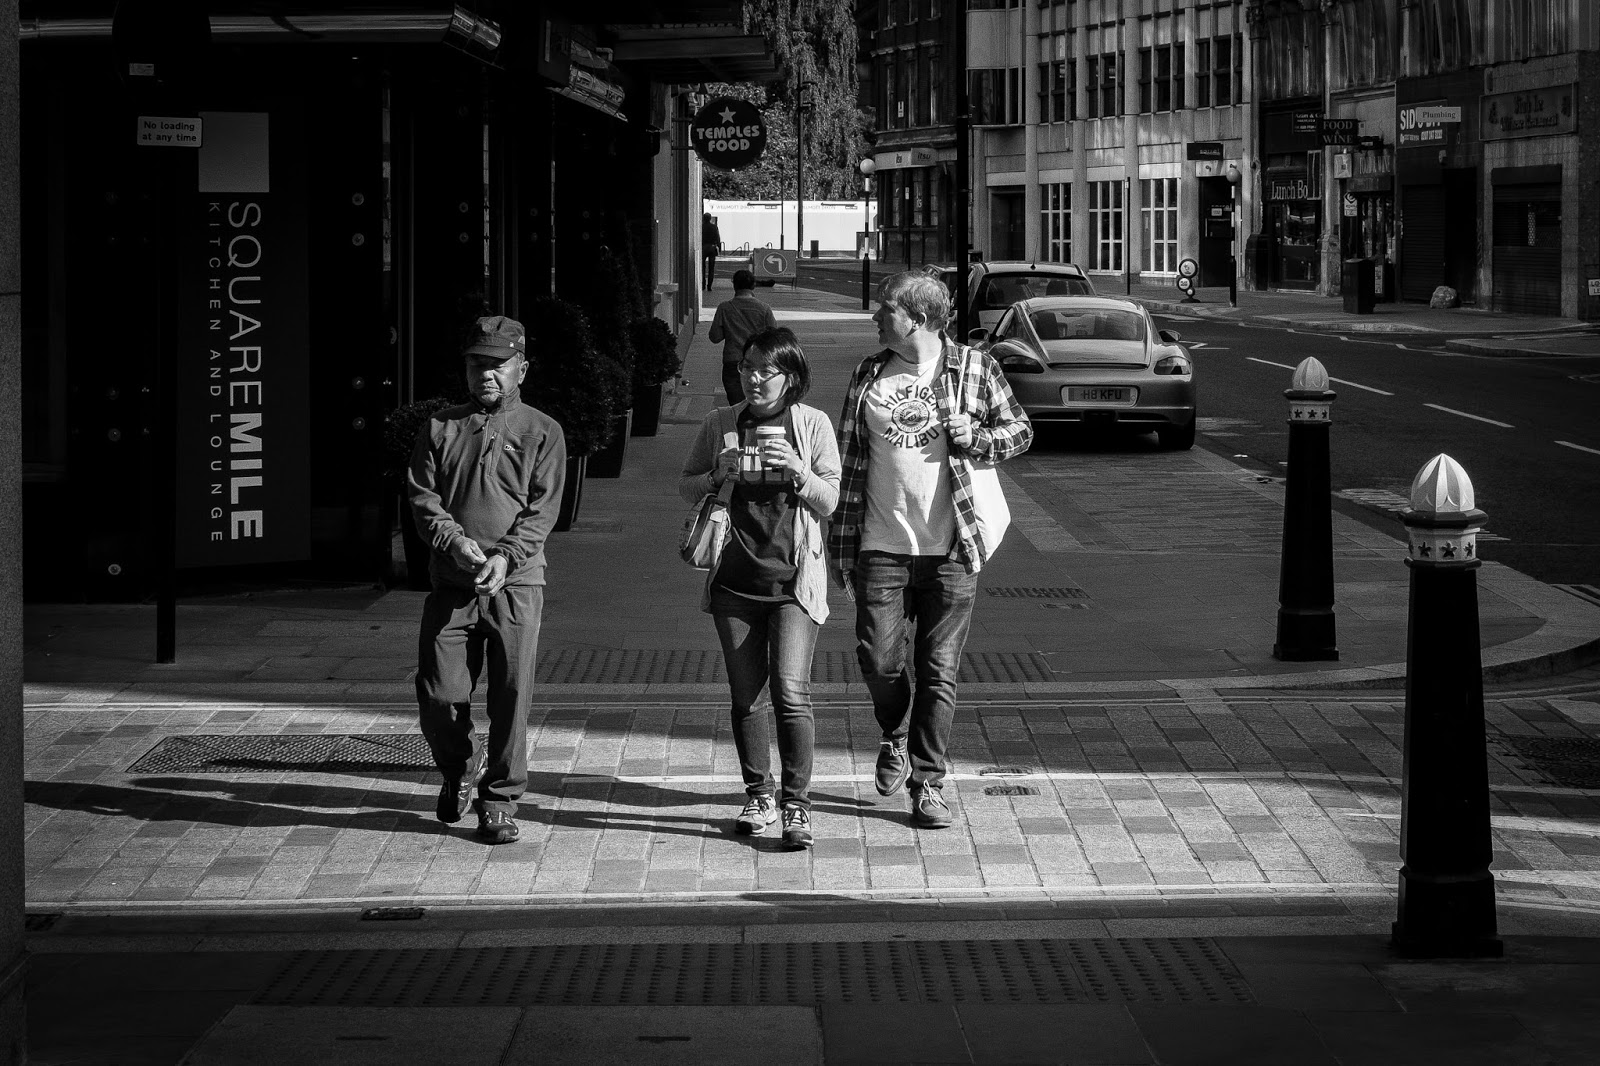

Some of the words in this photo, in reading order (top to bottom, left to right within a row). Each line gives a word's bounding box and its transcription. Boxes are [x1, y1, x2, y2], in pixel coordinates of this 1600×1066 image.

[1422, 111, 1456, 120] Plumbing
[144, 120, 157, 129] No
[161, 121, 195, 132] loading
[696, 124, 760, 139] TEMPLES
[1323, 121, 1354, 130] FOOD
[142, 132, 152, 141] at
[156, 134, 172, 142] any
[176, 133, 197, 142] time
[1322, 135, 1354, 144] WINE
[708, 138, 750, 152] FOOD
[917, 152, 931, 160] itsu
[1271, 180, 1296, 200] Lunch
[1297, 180, 1308, 199] Bo
[208, 201, 222, 331] KITCHEN
[209, 349, 222, 397] AND
[227, 201, 264, 540] SQUAREMILE
[1083, 389, 1097, 400] H8
[1100, 389, 1122, 400] KFU
[883, 426, 940, 449] MALIBU
[209, 413, 223, 542] LOUNGE
